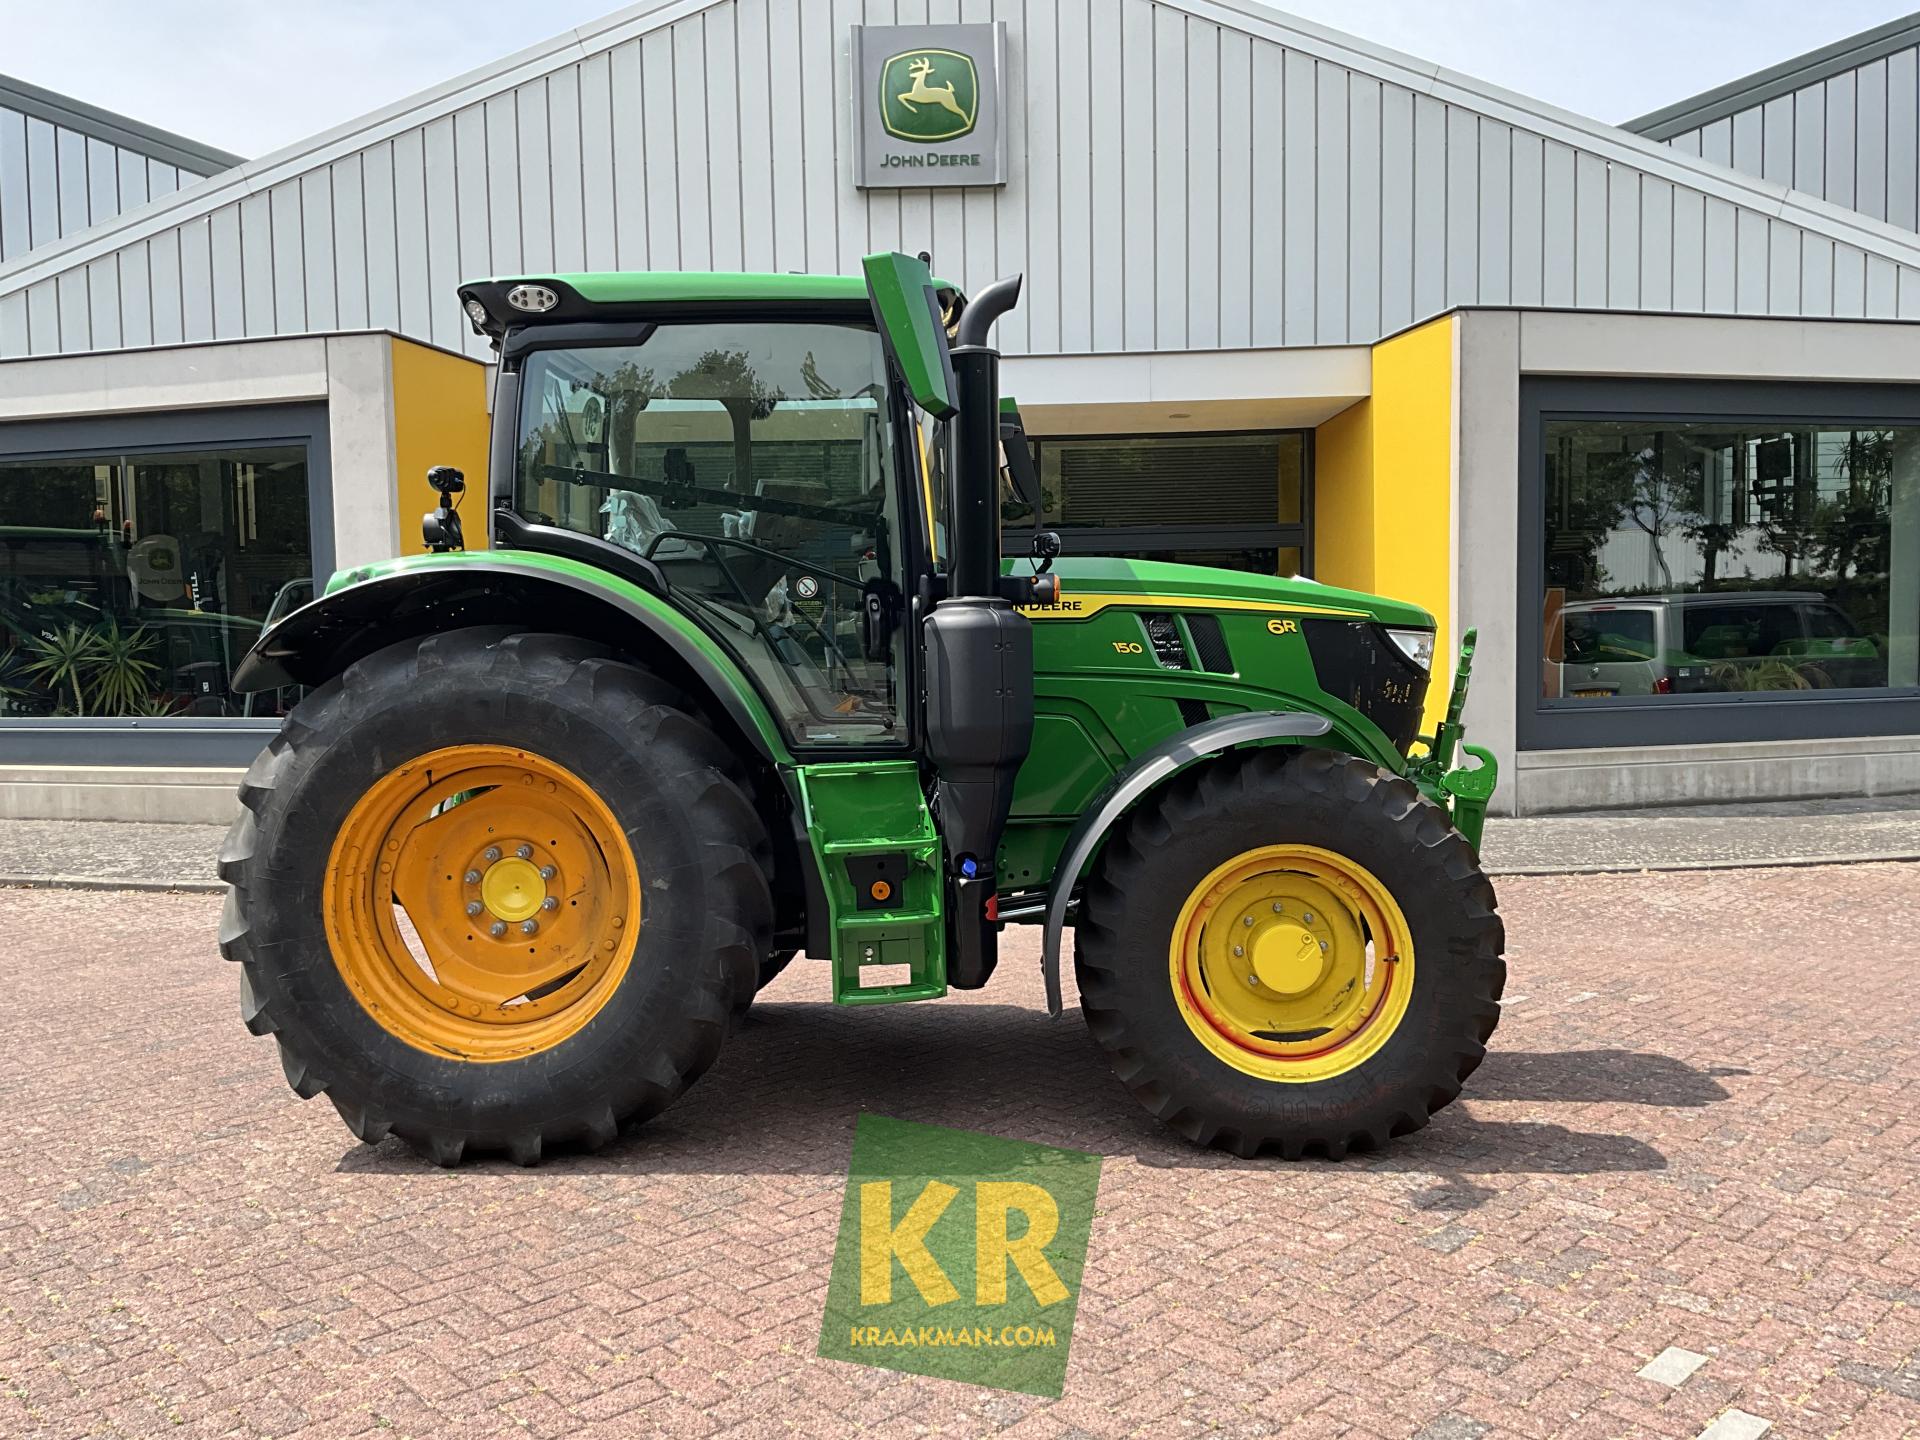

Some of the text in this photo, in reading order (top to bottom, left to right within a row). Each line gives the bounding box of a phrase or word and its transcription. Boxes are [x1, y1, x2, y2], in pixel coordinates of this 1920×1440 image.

[880, 152, 980, 168] JOHN DEERE
[1029, 601, 1082, 611] DEERE
[1266, 618, 1298, 635] 6R
[1112, 642, 1143, 654] 150
